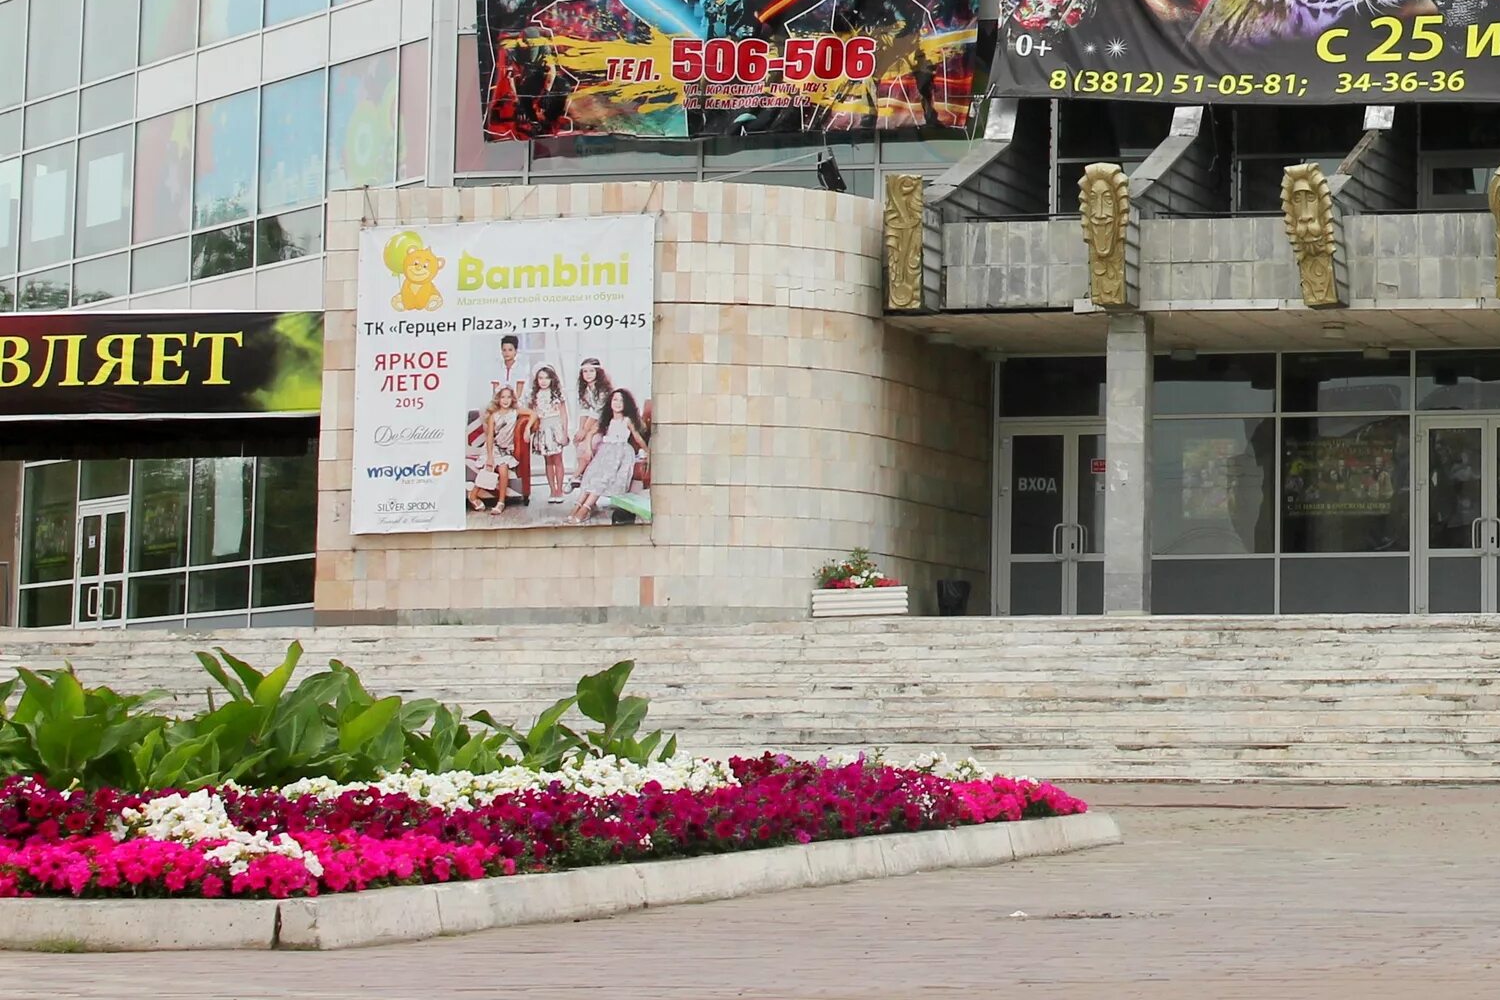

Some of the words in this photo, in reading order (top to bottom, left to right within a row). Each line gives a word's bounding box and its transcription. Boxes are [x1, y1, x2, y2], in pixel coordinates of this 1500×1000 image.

[1015, 34, 1053, 58] 0+
[1366, 14, 1444, 64] 25
[606, 56, 660, 82] ТЕЛ.
[671, 37, 876, 82] 506-506
[705, 82, 764, 96] КРАСНЫЙ
[770, 83, 797, 95] ПУТЬ
[1049, 69, 1068, 91] 8
[1073, 70, 1164, 97] (3812)
[1171, 72, 1309, 97] 51-05-81;
[1334, 69, 1466, 93] 34-36-36
[704, 96, 790, 109] КЕМЕРОВСКАЯ
[457, 250, 631, 291] Bambini
[500, 294, 541, 305] детской
[593, 292, 624, 302] обуви
[364, 322, 385, 336] ТК
[389, 320, 457, 337] «Герцен
[462, 316, 517, 333] Plaza»,
[582, 313, 646, 330] 909-425
[0, 331, 243, 388] ВЛЯЕТ
[374, 351, 449, 371] ЯРКОЕ
[380, 373, 440, 392] ЛЕТО
[395, 397, 424, 409] 2015
[367, 461, 431, 481] mayoral
[1018, 477, 1057, 493] ВХОД
[377, 501, 405, 512] SILVER
[407, 502, 436, 511] SPOON
